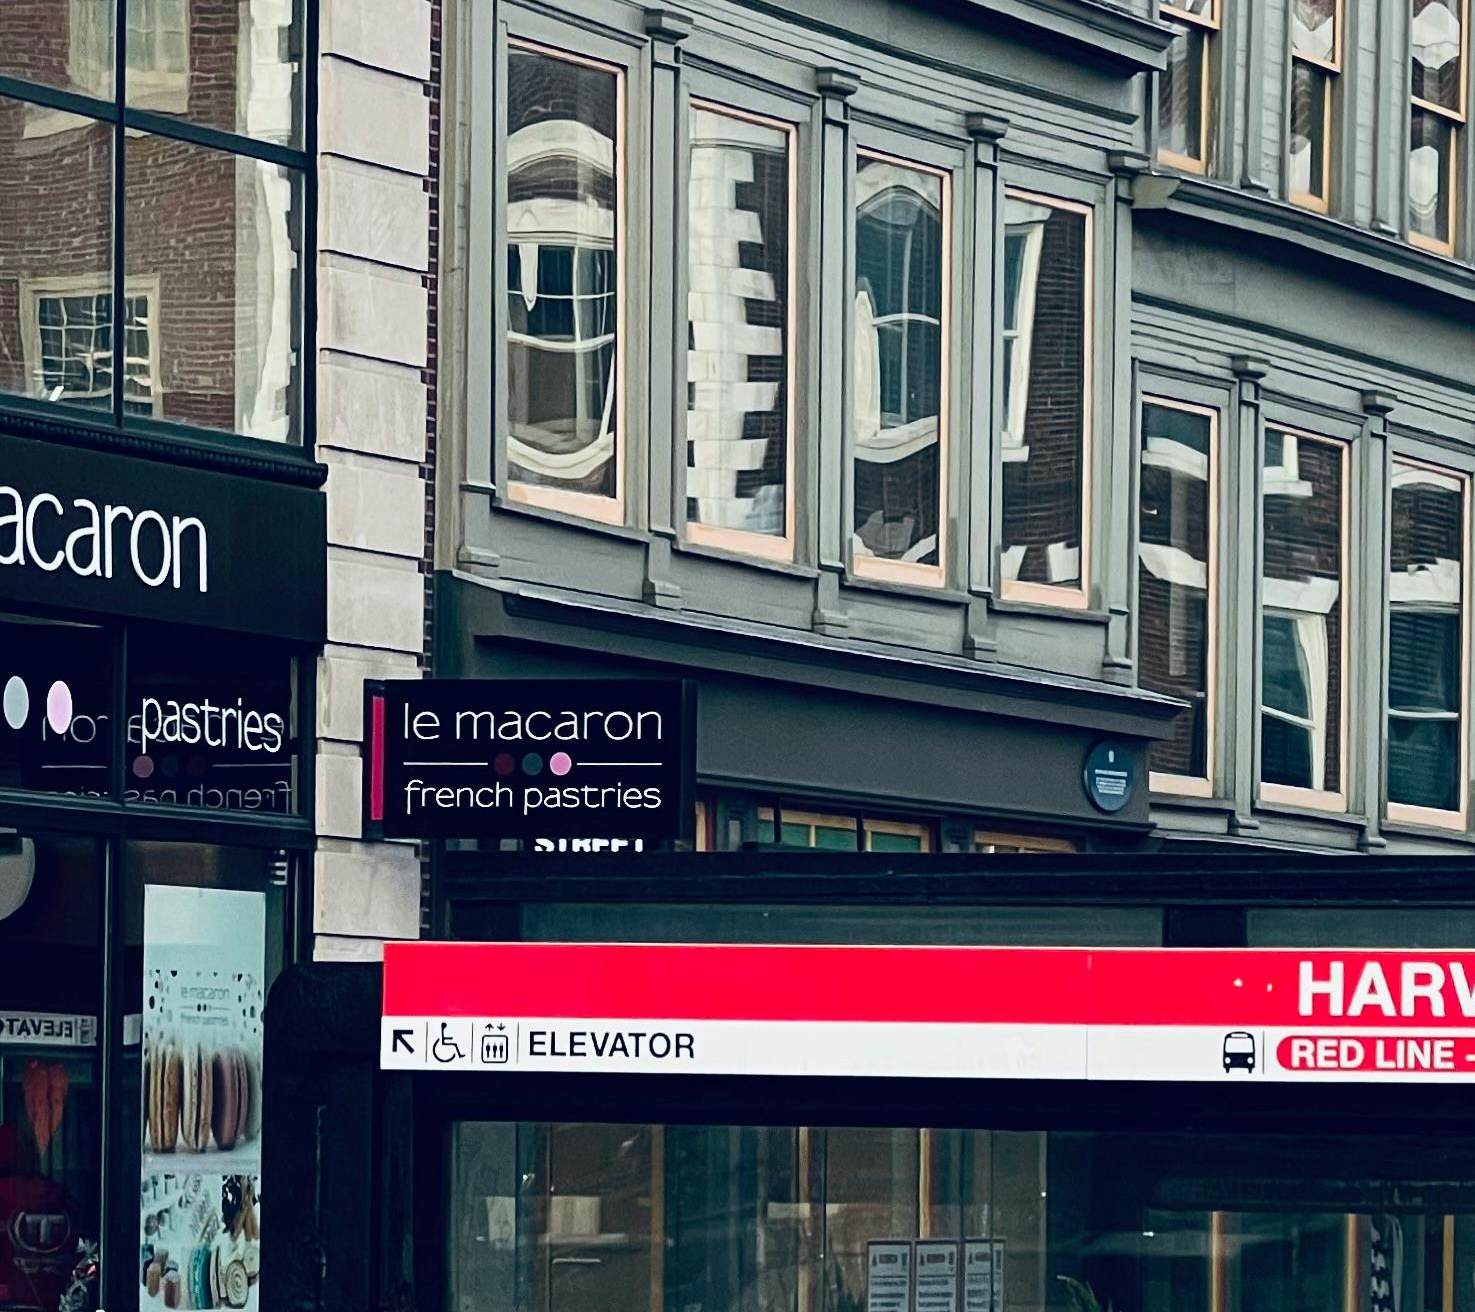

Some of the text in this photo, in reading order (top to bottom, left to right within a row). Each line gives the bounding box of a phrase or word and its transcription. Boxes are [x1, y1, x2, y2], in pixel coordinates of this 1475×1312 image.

[141, 697, 283, 754] pastries
[403, 702, 662, 741] le macaron
[404, 779, 662, 816] french pastries
[528, 1030, 696, 1060] ELEVATOR
[1290, 1039, 1364, 1070] RED
[1375, 1040, 1456, 1070] LINE
